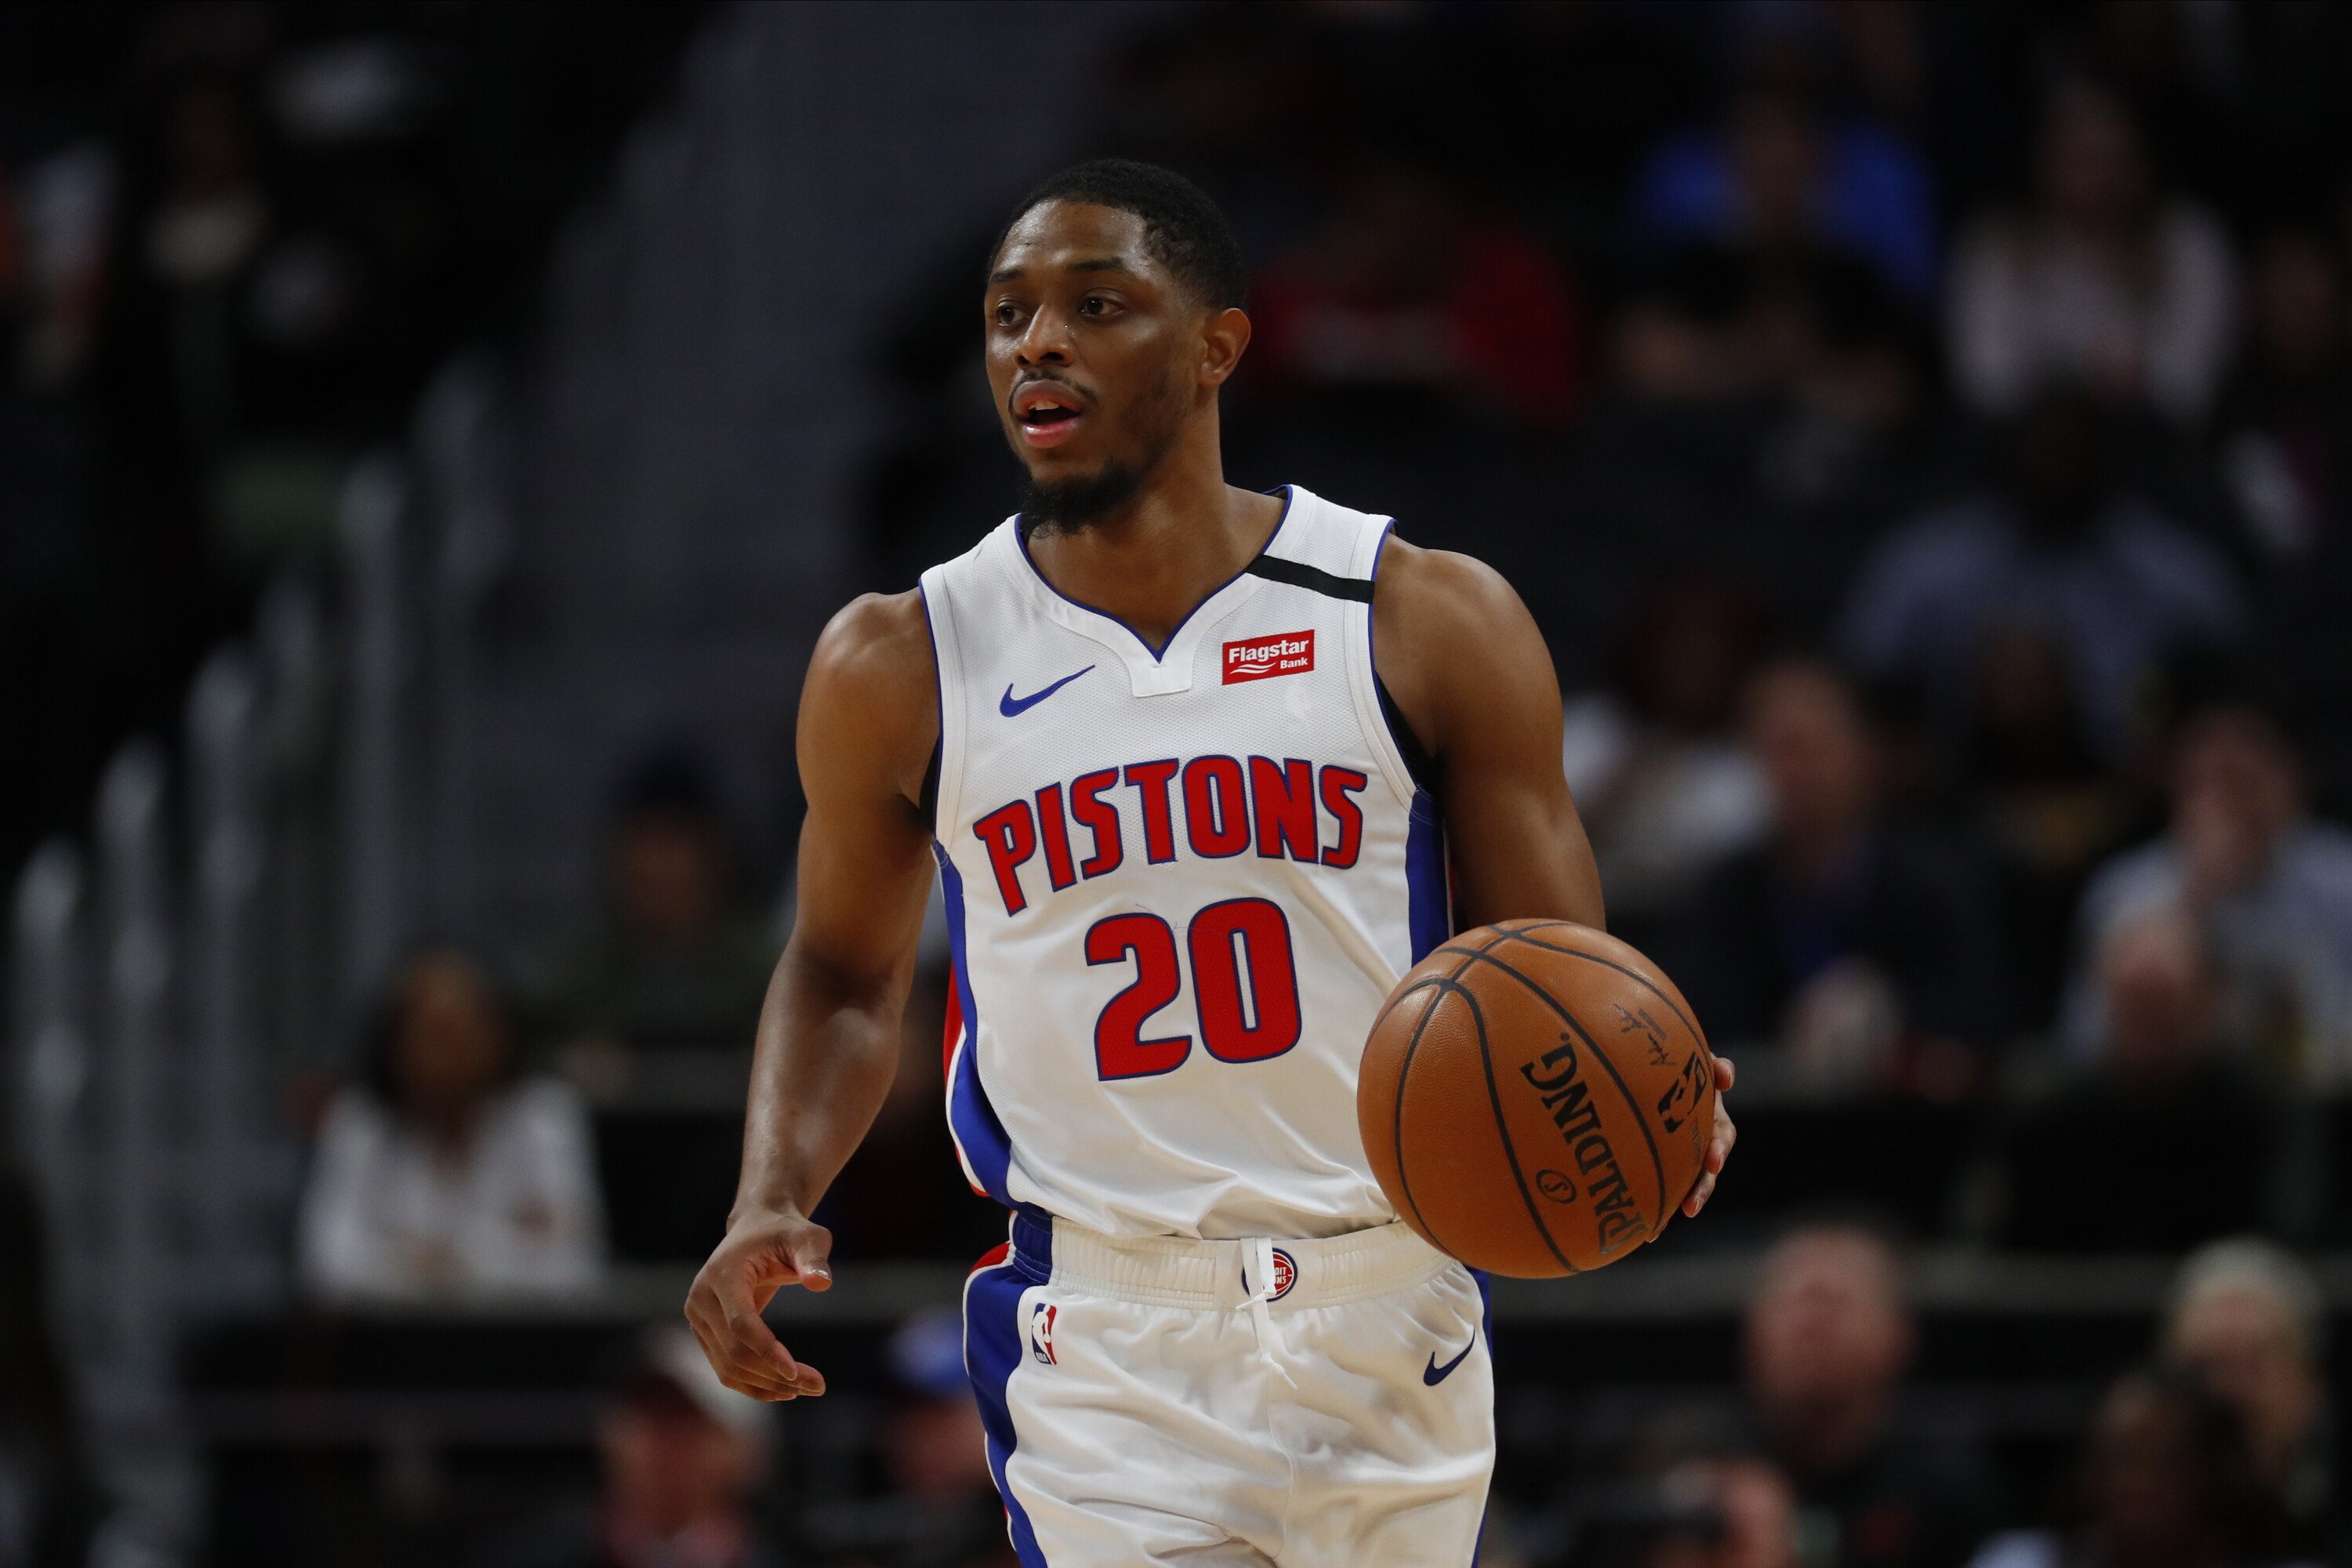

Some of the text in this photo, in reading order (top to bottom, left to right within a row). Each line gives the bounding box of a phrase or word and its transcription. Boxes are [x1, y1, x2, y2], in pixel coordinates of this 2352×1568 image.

[1229, 640, 1309, 663] Flagstar
[1279, 657, 1308, 670] Bank
[972, 754, 1368, 917] PISTONS
[1084, 896, 1302, 1082] 20
